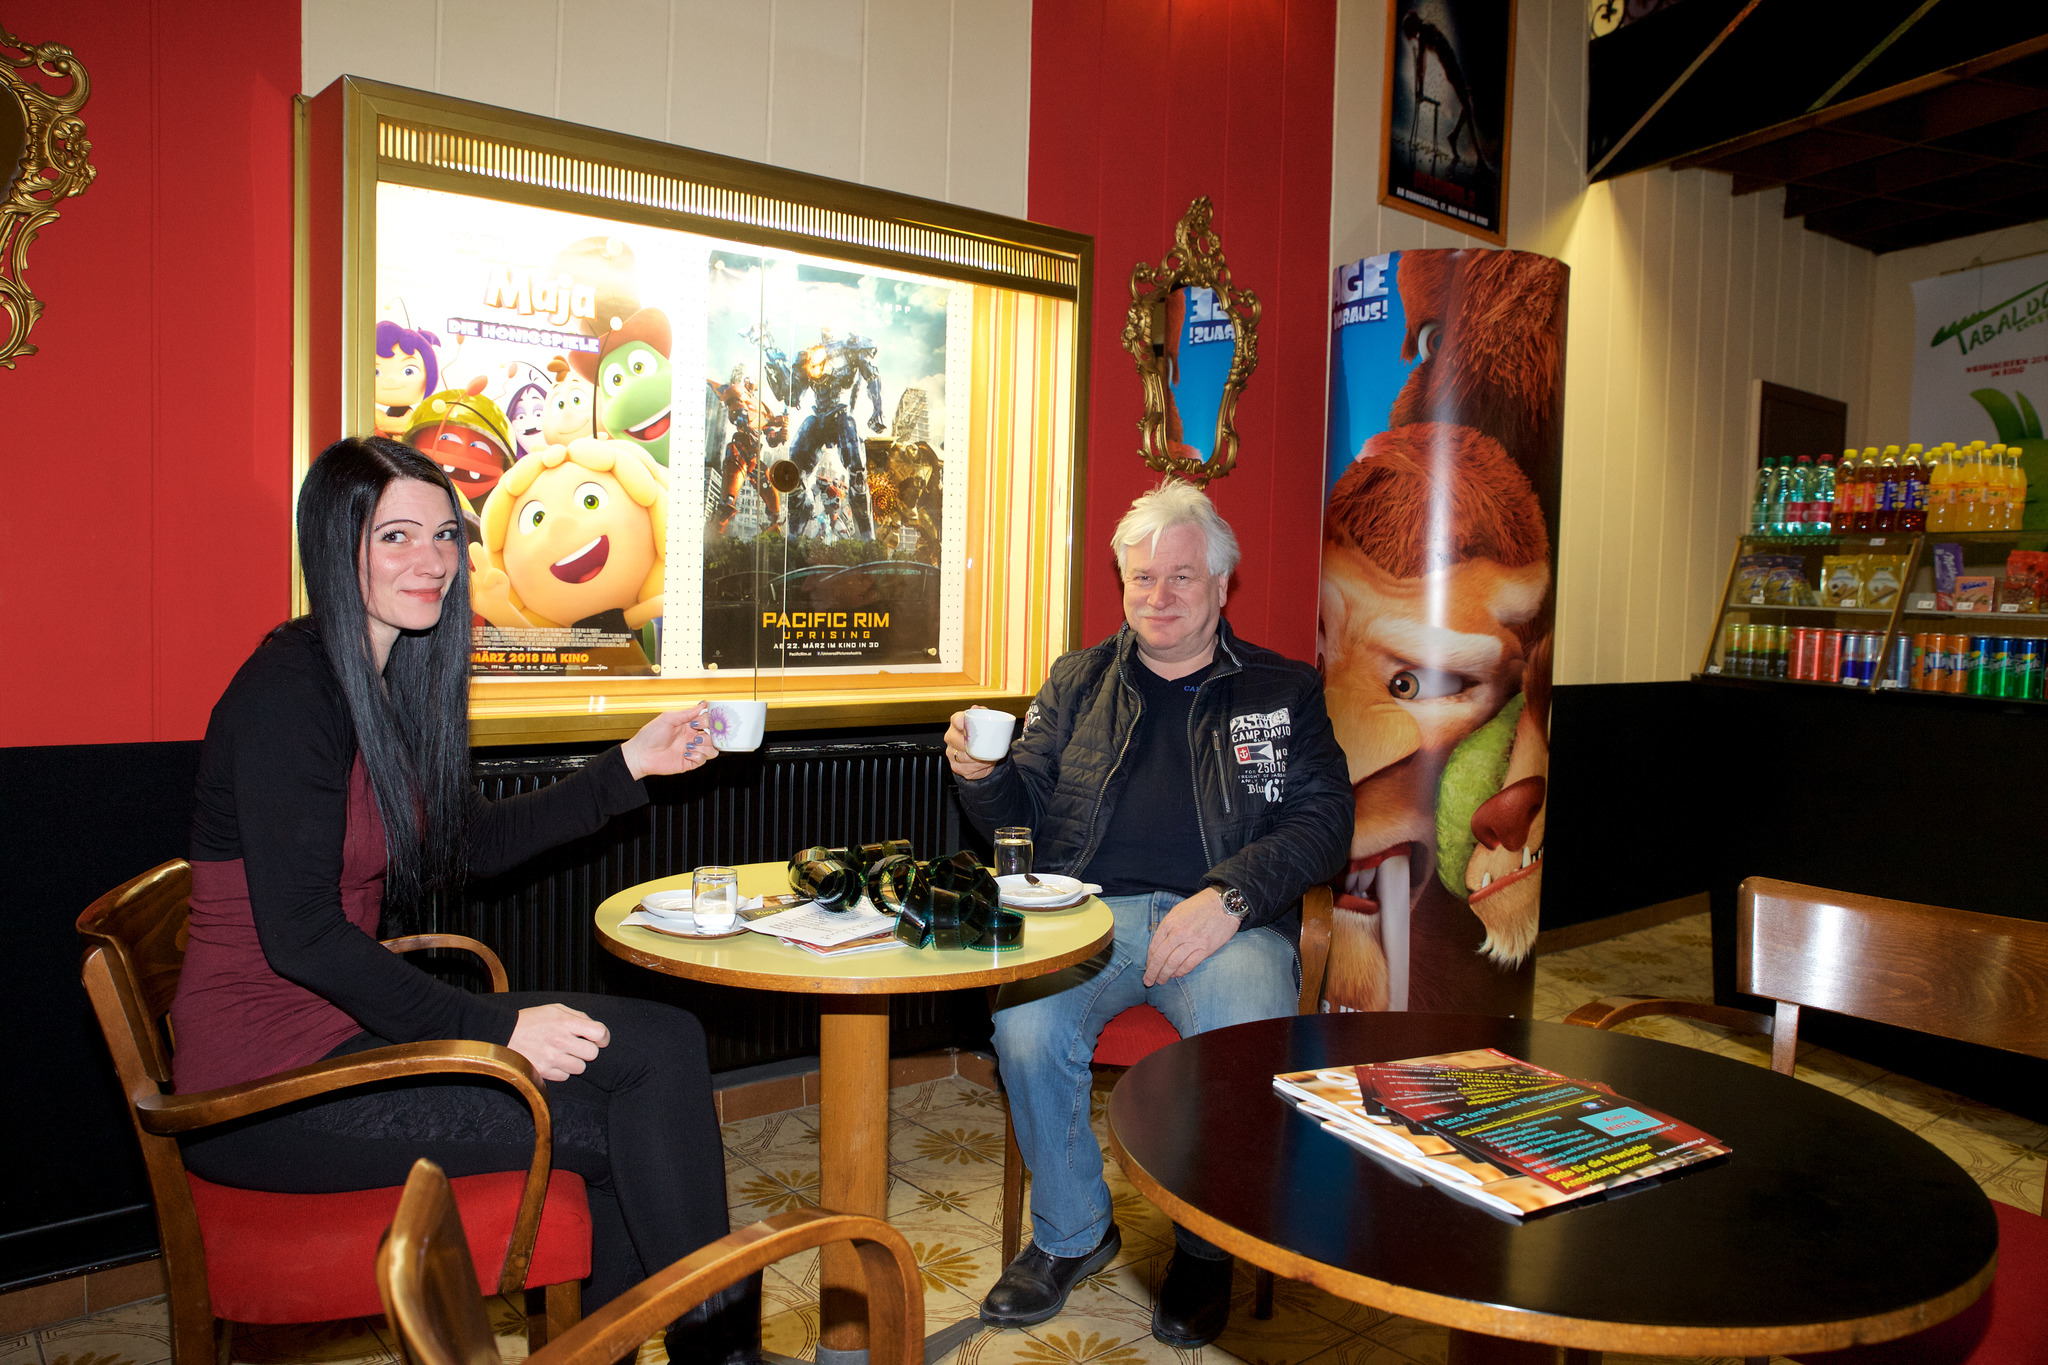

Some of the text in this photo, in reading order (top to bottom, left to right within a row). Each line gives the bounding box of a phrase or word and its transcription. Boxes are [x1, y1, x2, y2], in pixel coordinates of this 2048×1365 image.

[483, 264, 598, 326] Maja
[447, 318, 600, 353] DIE HONIGSPIELE
[762, 612, 890, 628] PACIFIC RIM
[784, 631, 871, 640] UPRISING
[802, 641, 826, 649] MÄRZ
[507, 653, 540, 663] 2018
[541, 653, 557, 663] IM
[559, 653, 590, 663] KINO
[1231, 726, 1291, 743] CAMP DAVID
[1256, 761, 1288, 774] 25016
[1246, 783, 1266, 795] Blu
[1434, 1116, 1464, 1126] Kino
[1460, 1107, 1500, 1118] Ternitz
[1498, 1101, 1521, 1109] und
[1602, 1114, 1626, 1122] Kino
[1604, 1119, 1643, 1132] MIETEN
[1546, 1143, 1651, 1181] Bitte für die Newsletter
[1560, 1166, 1620, 1189] Anmeldung
